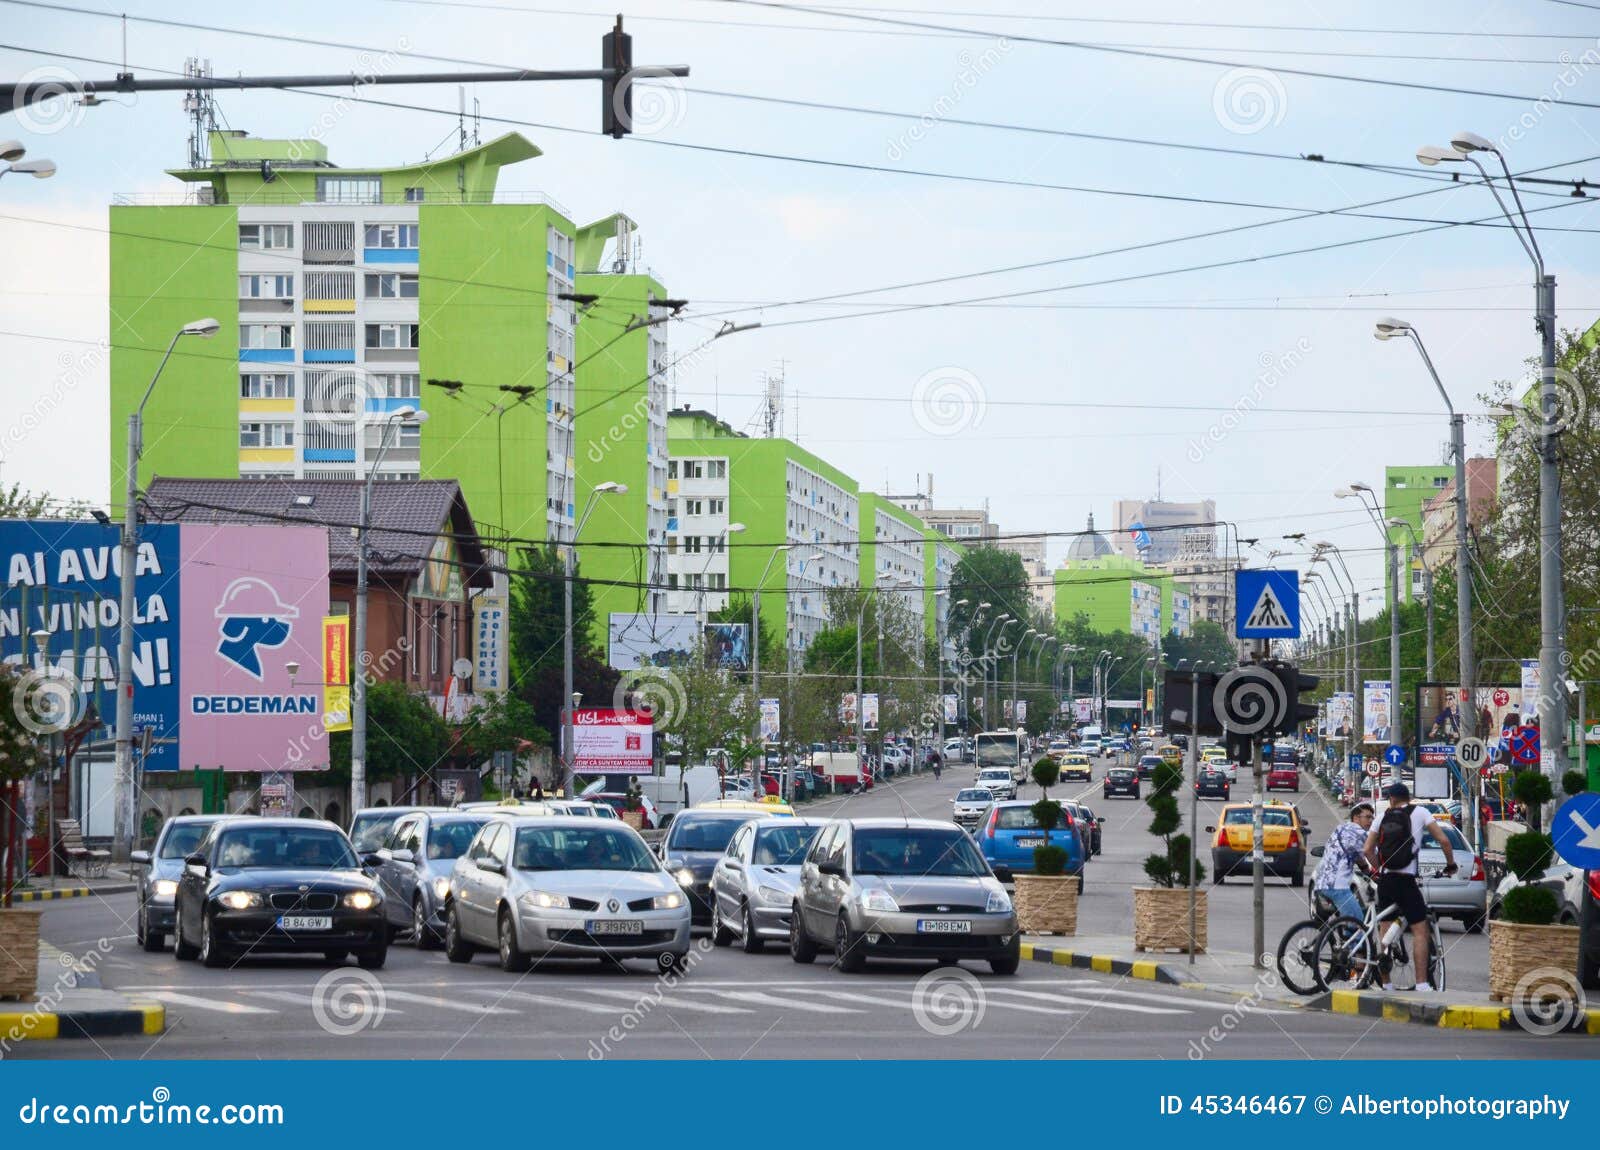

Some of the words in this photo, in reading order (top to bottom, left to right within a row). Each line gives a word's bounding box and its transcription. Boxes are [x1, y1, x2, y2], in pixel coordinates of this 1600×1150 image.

[8, 552, 46, 587] AI
[38, 599, 119, 632] VINO
[133, 595, 168, 624] LA
[193, 696, 316, 713] DEDEMAN
[577, 712, 603, 724] USL
[1462, 743, 1480, 761] 60
[293, 919, 305, 928] 84
